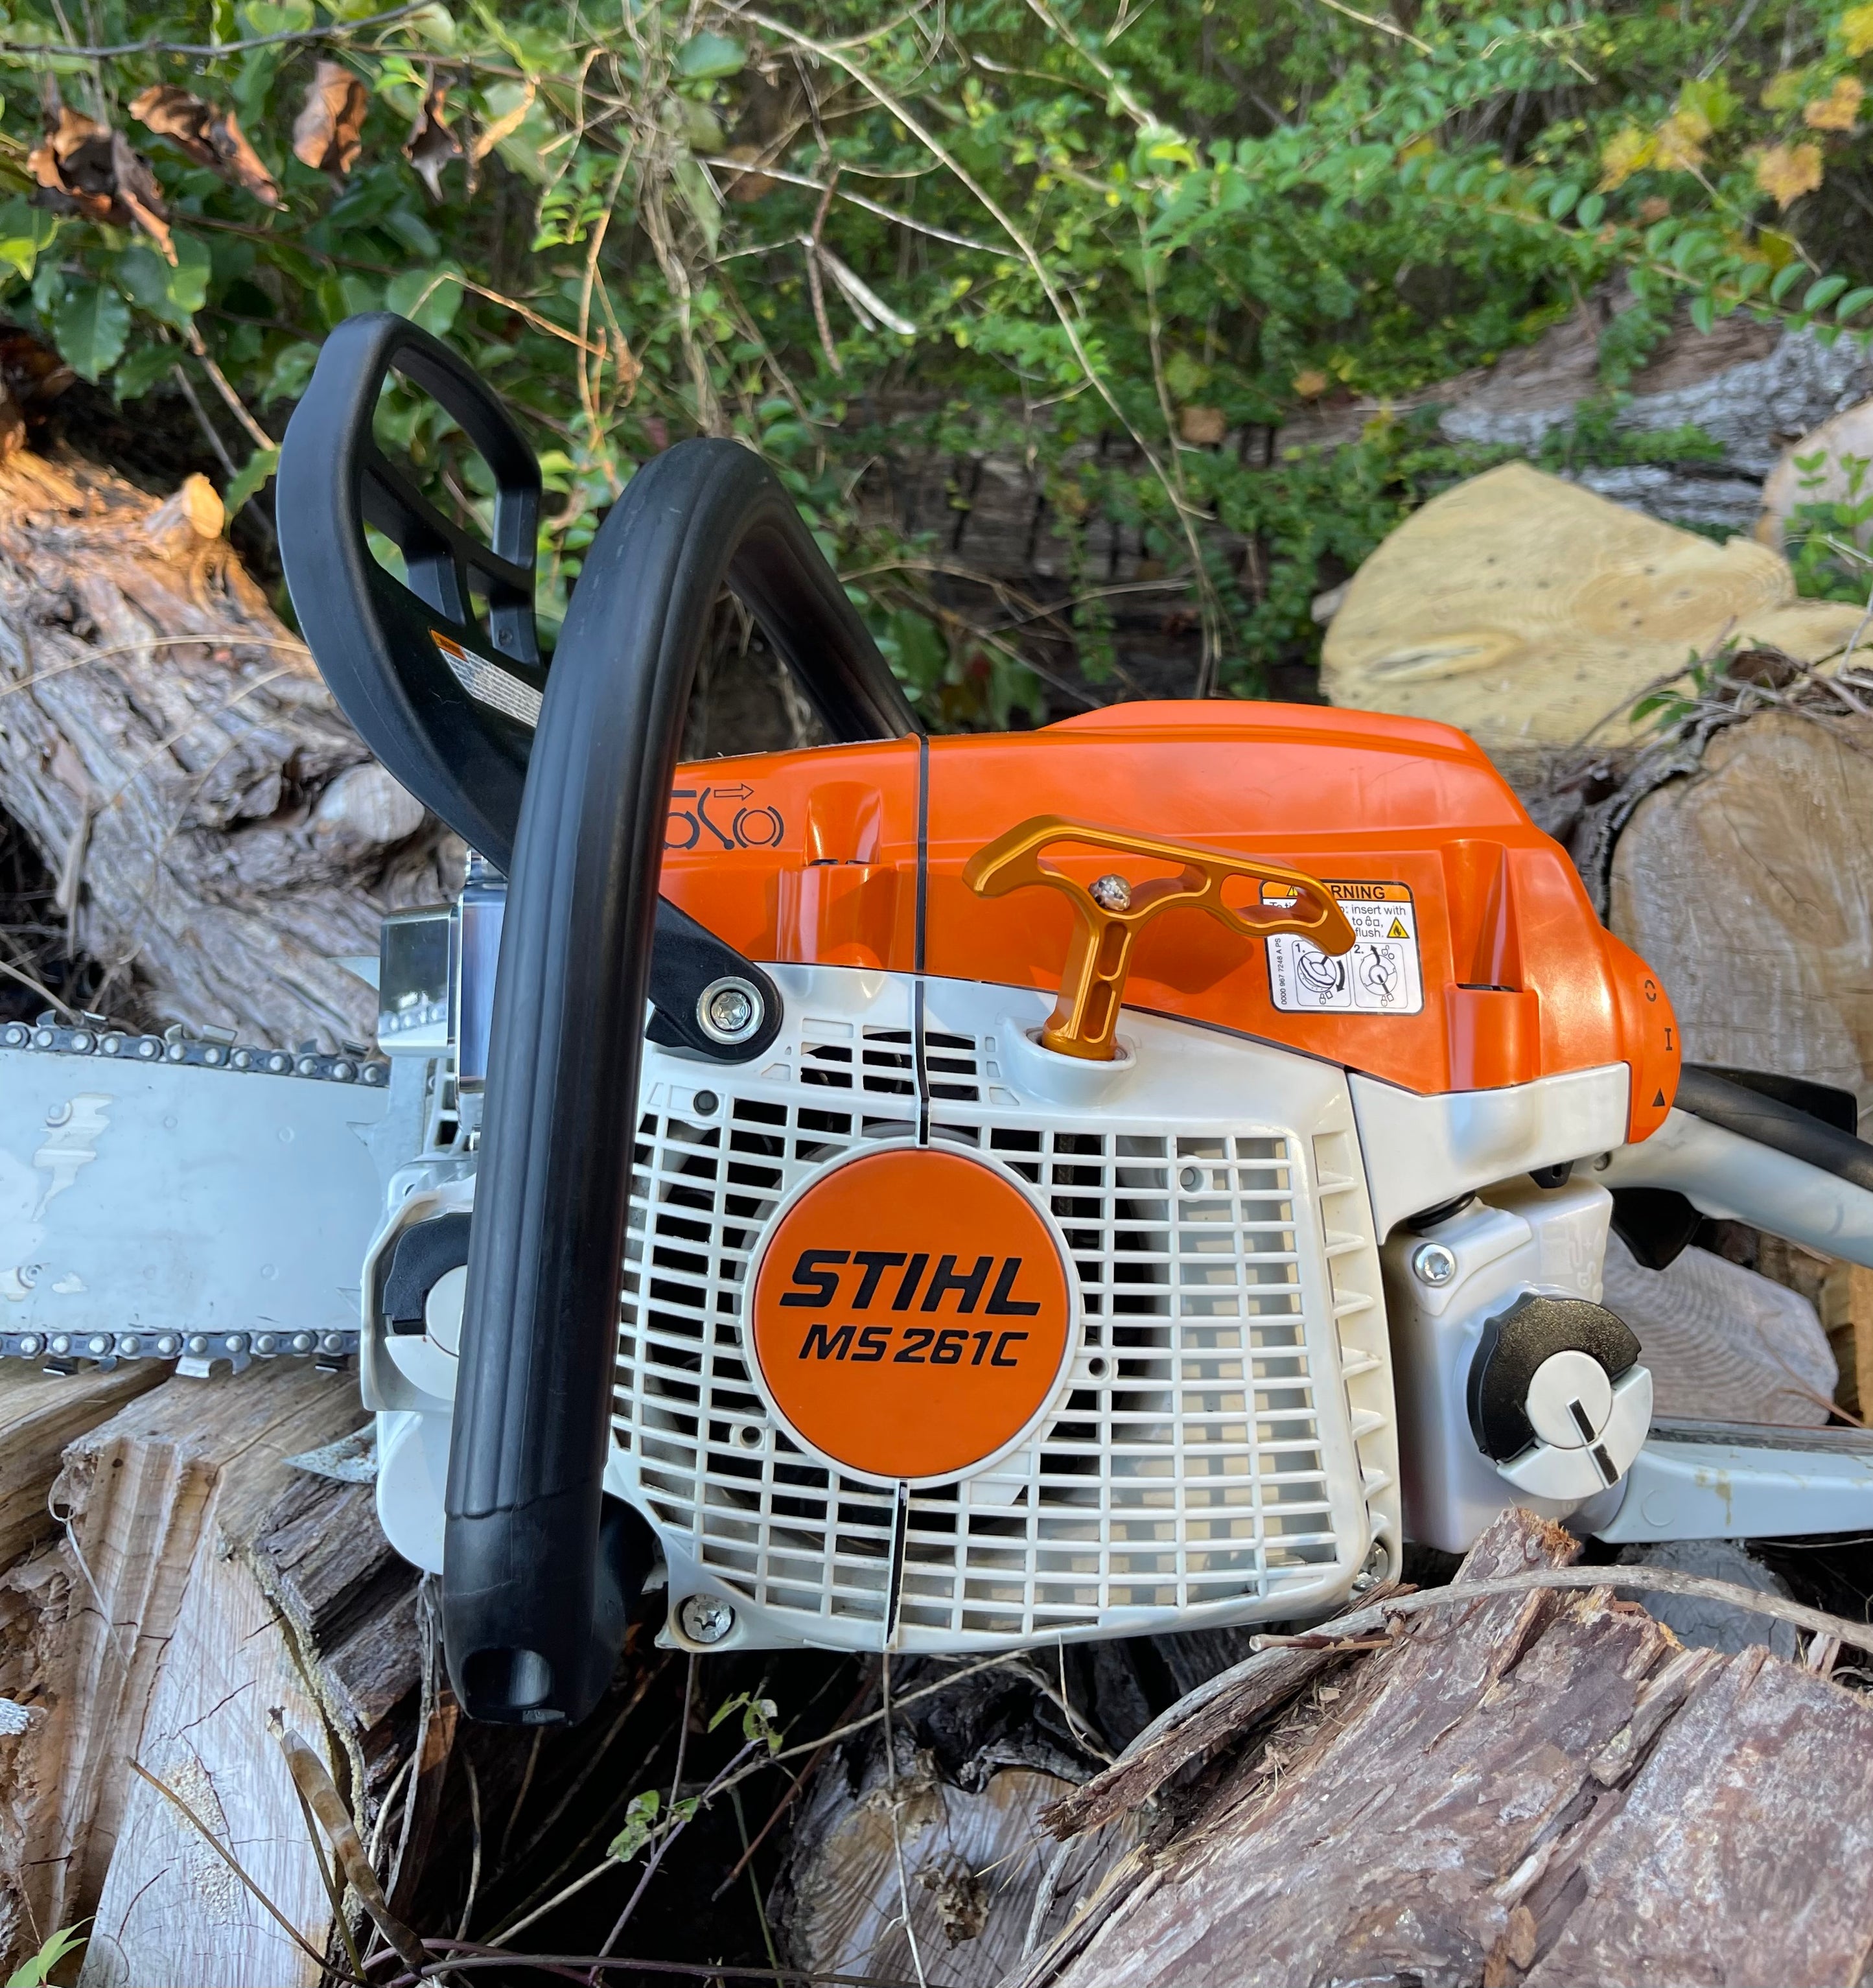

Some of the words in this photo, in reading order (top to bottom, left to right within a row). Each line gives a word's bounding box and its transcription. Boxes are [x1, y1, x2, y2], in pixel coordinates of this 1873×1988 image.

[1331, 885, 1385, 900] RNING
[1351, 904, 1381, 915] insert
[1384, 906, 1406, 915] with
[1352, 917, 1363, 926] to
[1355, 928, 1384, 938] flush.
[1275, 938, 1281, 948] PS
[1295, 943, 1305, 953] 1.
[1354, 944, 1364, 953] 2.
[780, 1249, 1041, 1316] STIHL
